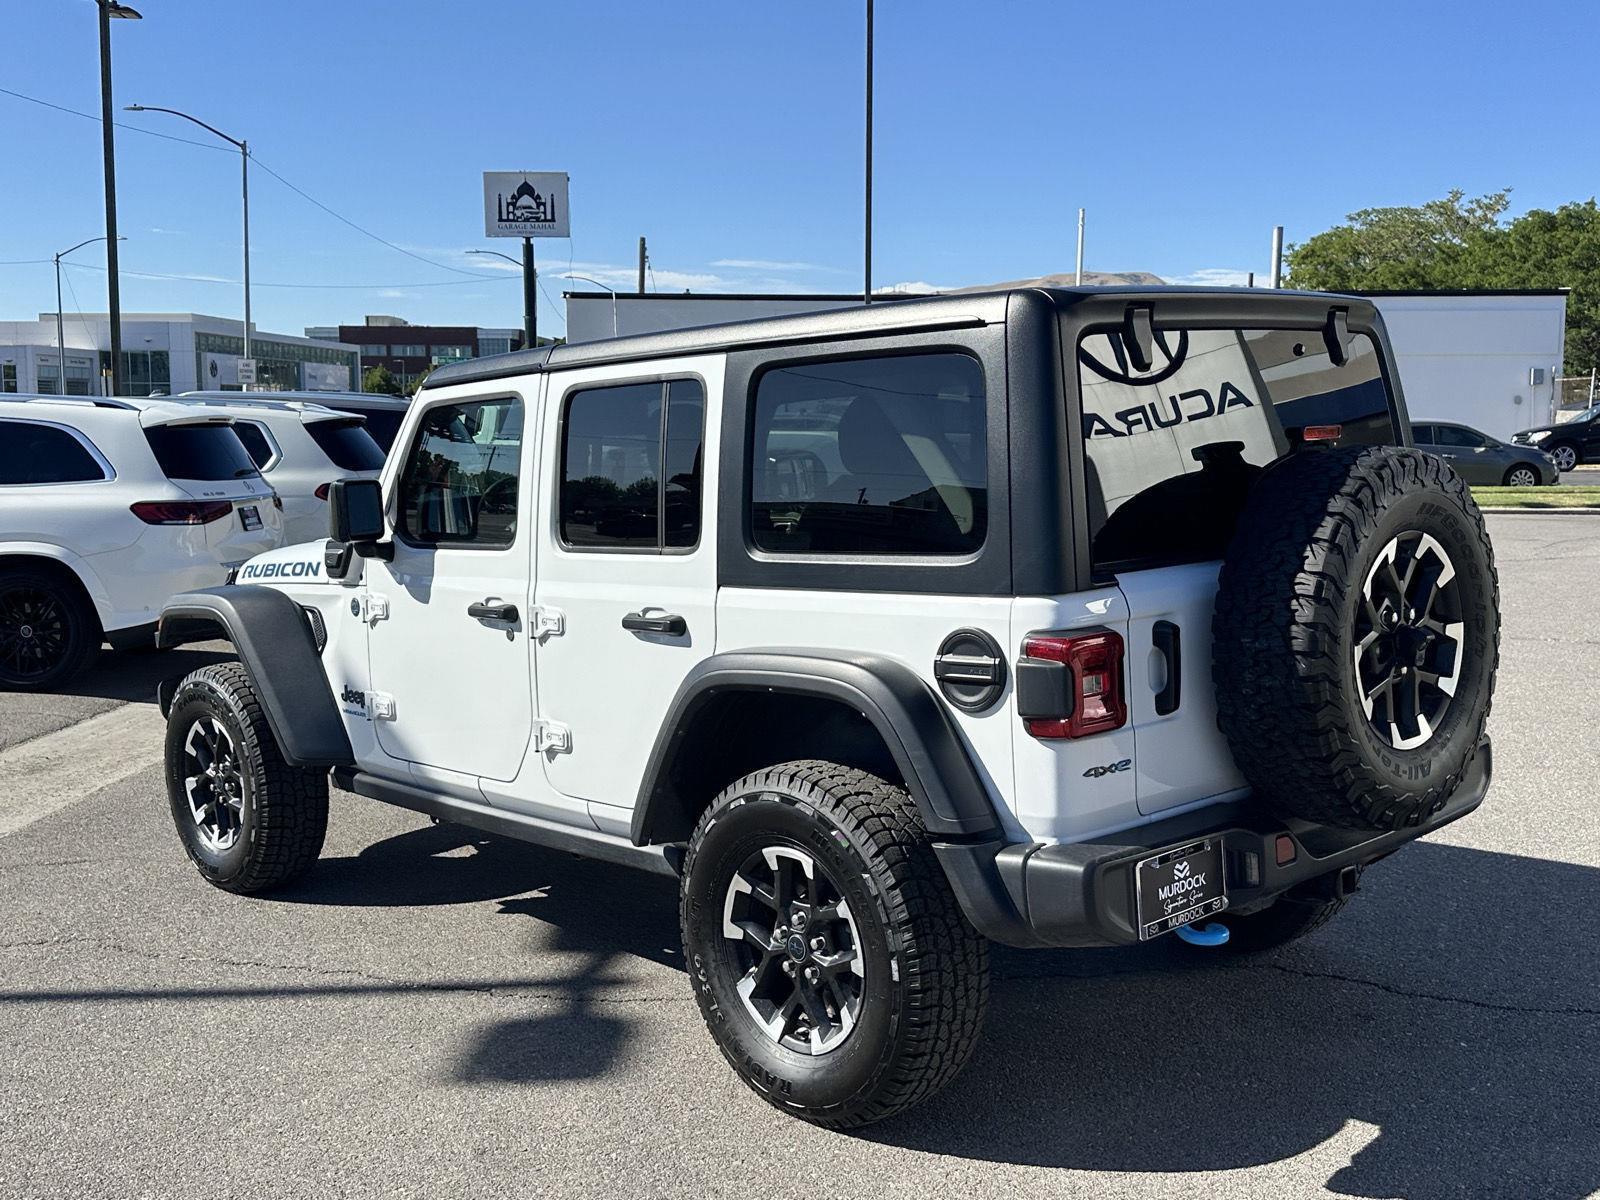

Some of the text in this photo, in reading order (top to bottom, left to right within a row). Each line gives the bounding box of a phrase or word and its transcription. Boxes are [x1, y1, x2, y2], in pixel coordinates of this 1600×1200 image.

[242, 561, 321, 579] RUBICON
[341, 684, 366, 709] Jeep
[1158, 872, 1207, 901] MURDOCK
[1168, 906, 1205, 928] MURDOCK
